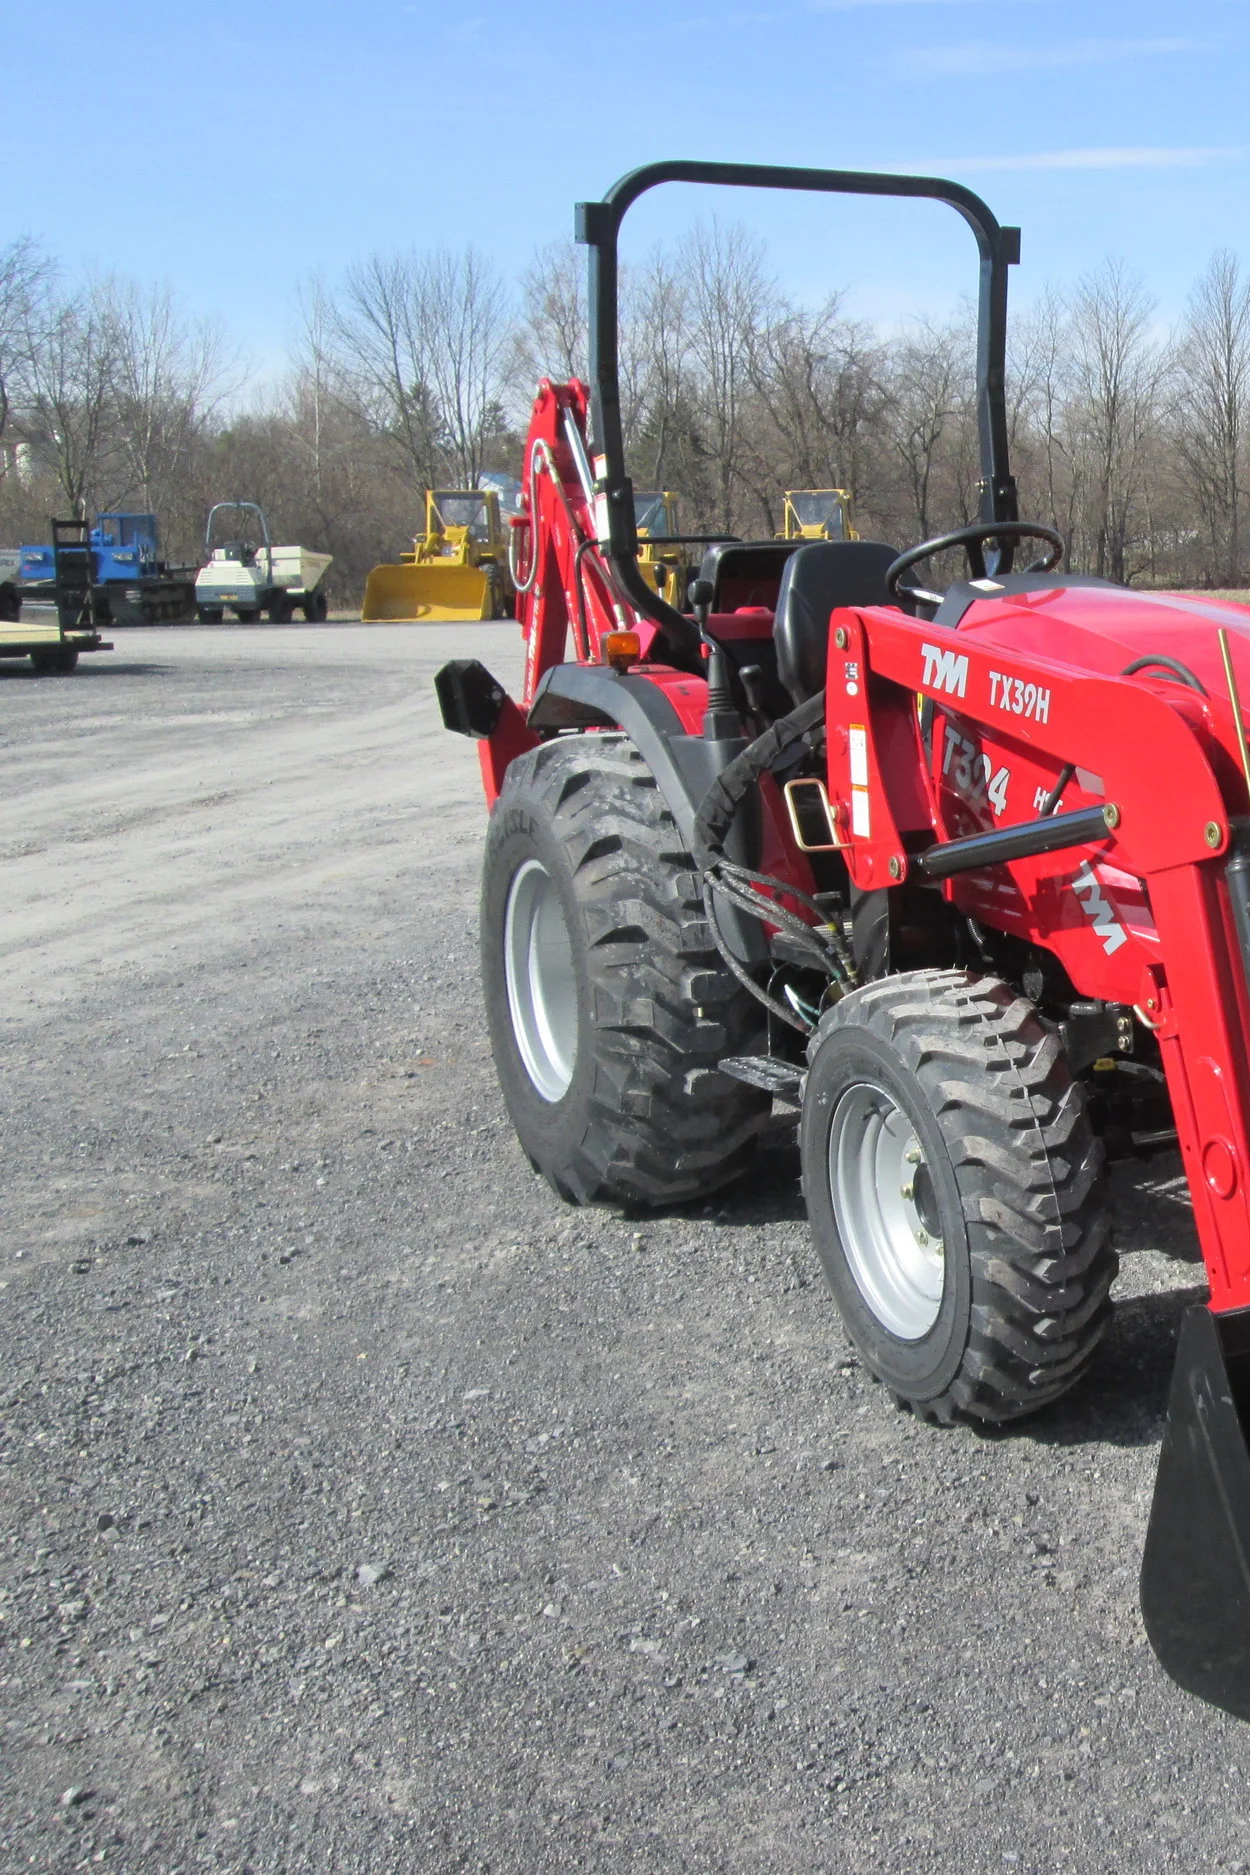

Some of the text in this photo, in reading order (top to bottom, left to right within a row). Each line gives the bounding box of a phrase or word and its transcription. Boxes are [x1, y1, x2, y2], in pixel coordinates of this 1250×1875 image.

[921, 643, 969, 698] TYM
[989, 670, 1051, 724] TX39H
[943, 725, 1011, 817] T324
[1071, 859, 1128, 956] TYM
